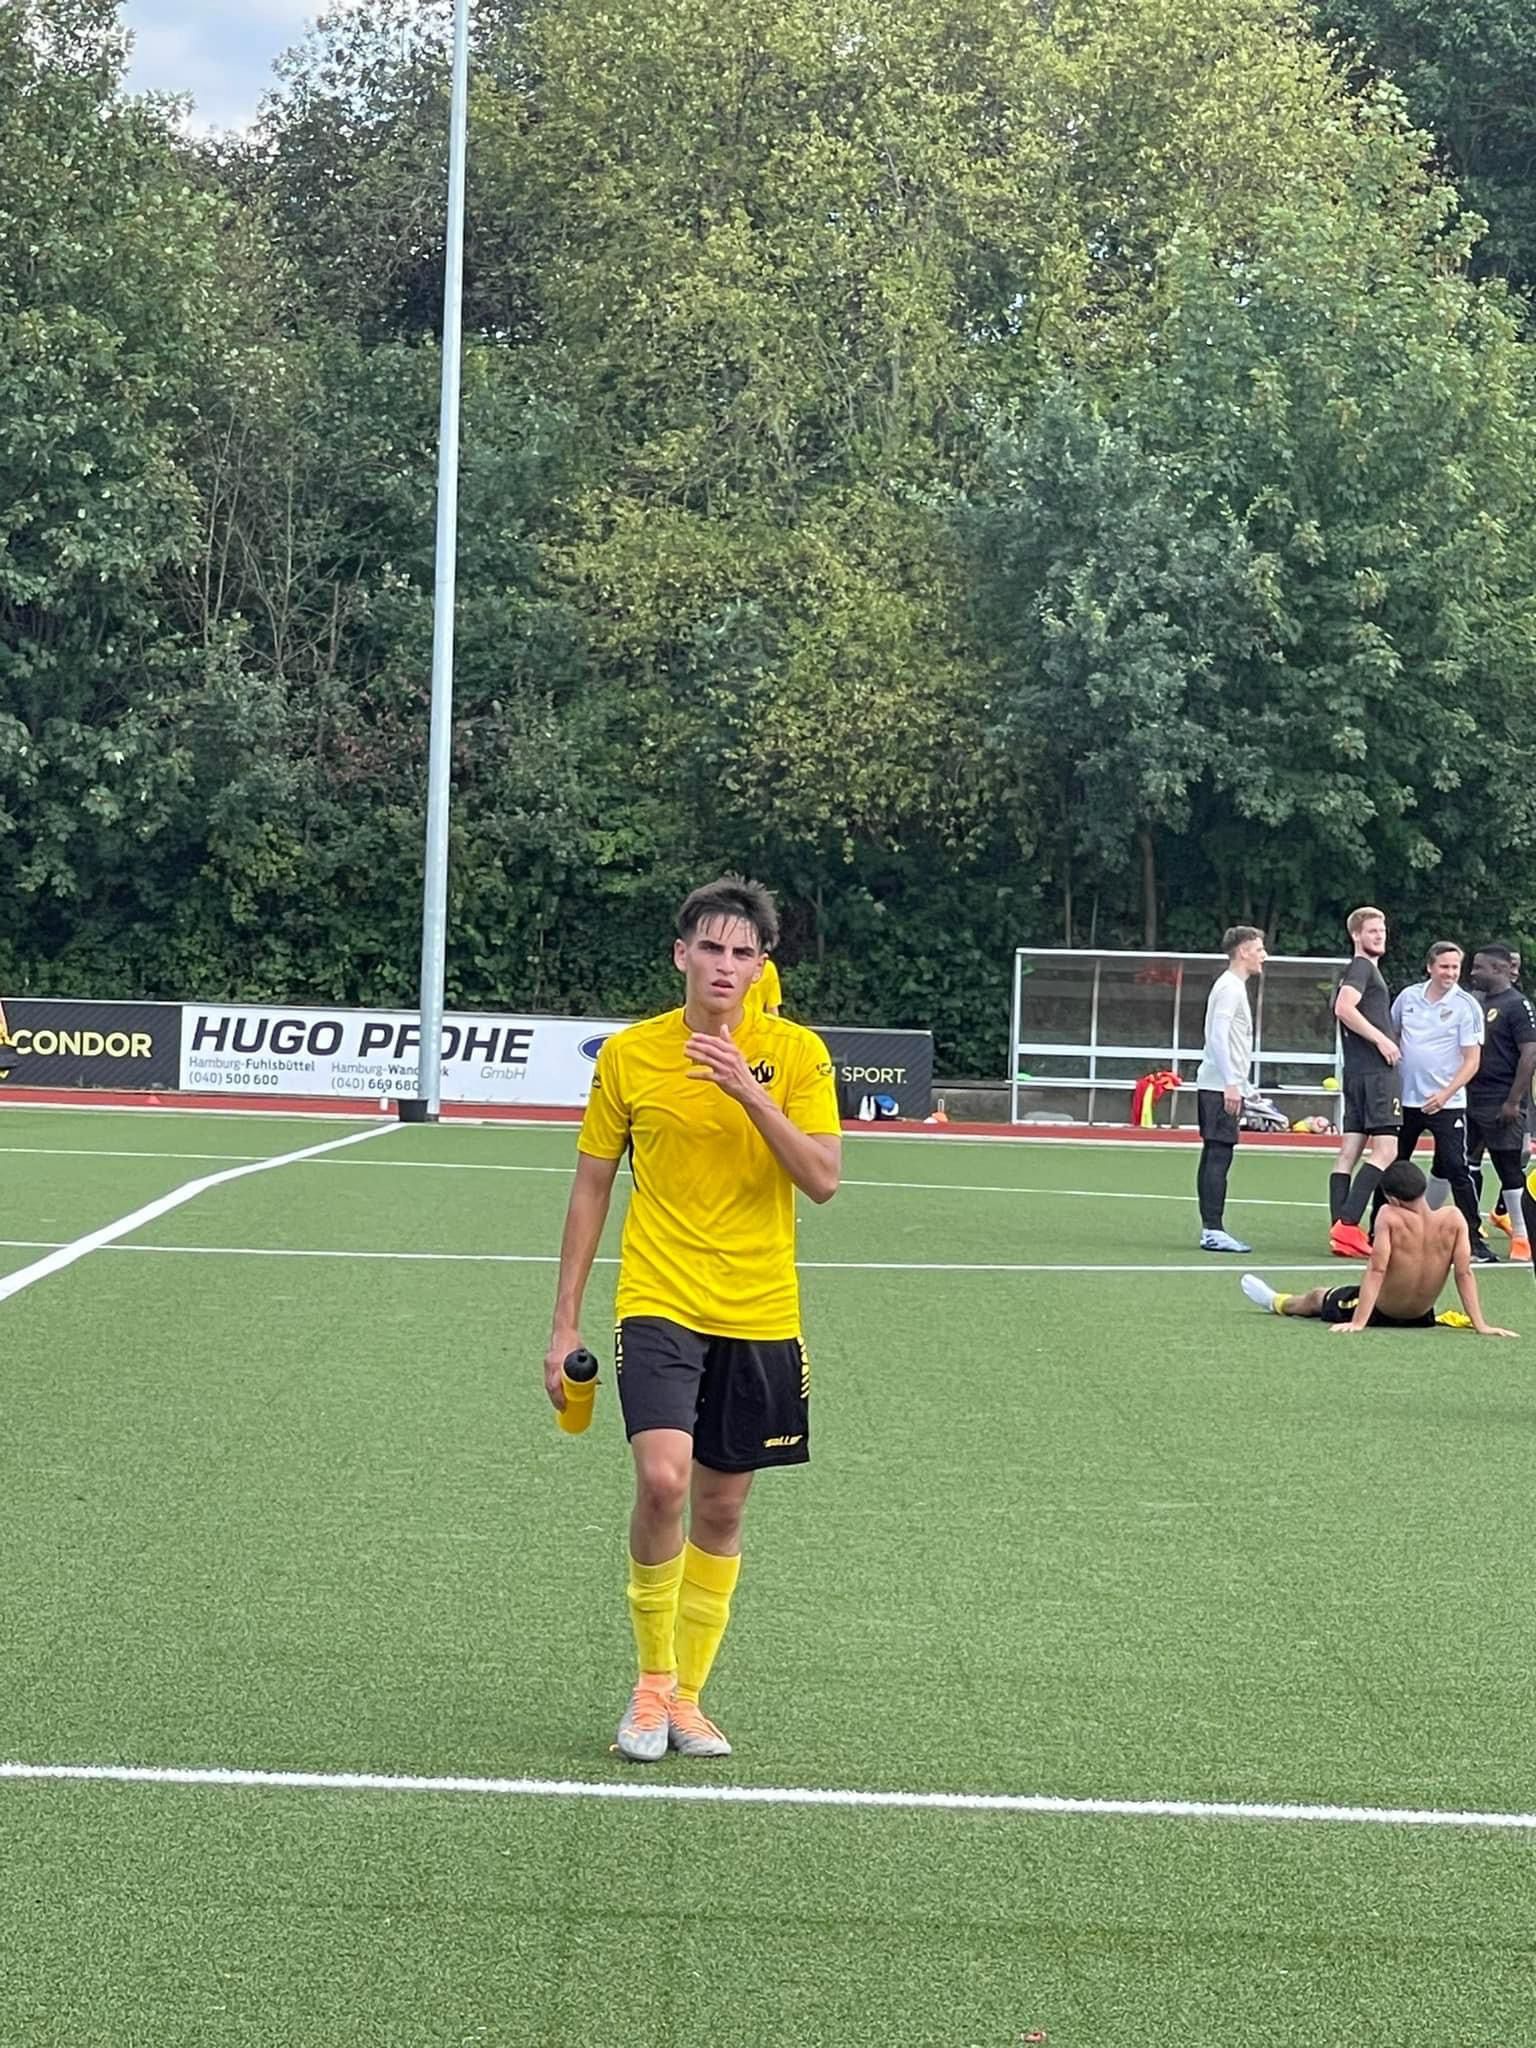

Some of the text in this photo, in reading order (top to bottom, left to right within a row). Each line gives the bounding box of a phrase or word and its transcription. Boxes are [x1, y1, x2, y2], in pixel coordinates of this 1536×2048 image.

[11, 1029, 153, 1058] CONDOR
[191, 1016, 344, 1056] HUGO
[188, 1056, 315, 1072] Hamburg-Fuhlsbüttel
[188, 1071, 279, 1086] (040) 500 600
[480, 1065, 527, 1080] GmbH
[841, 1066, 908, 1084] SPORT.
[331, 1077, 420, 1091] (040) 669 680
